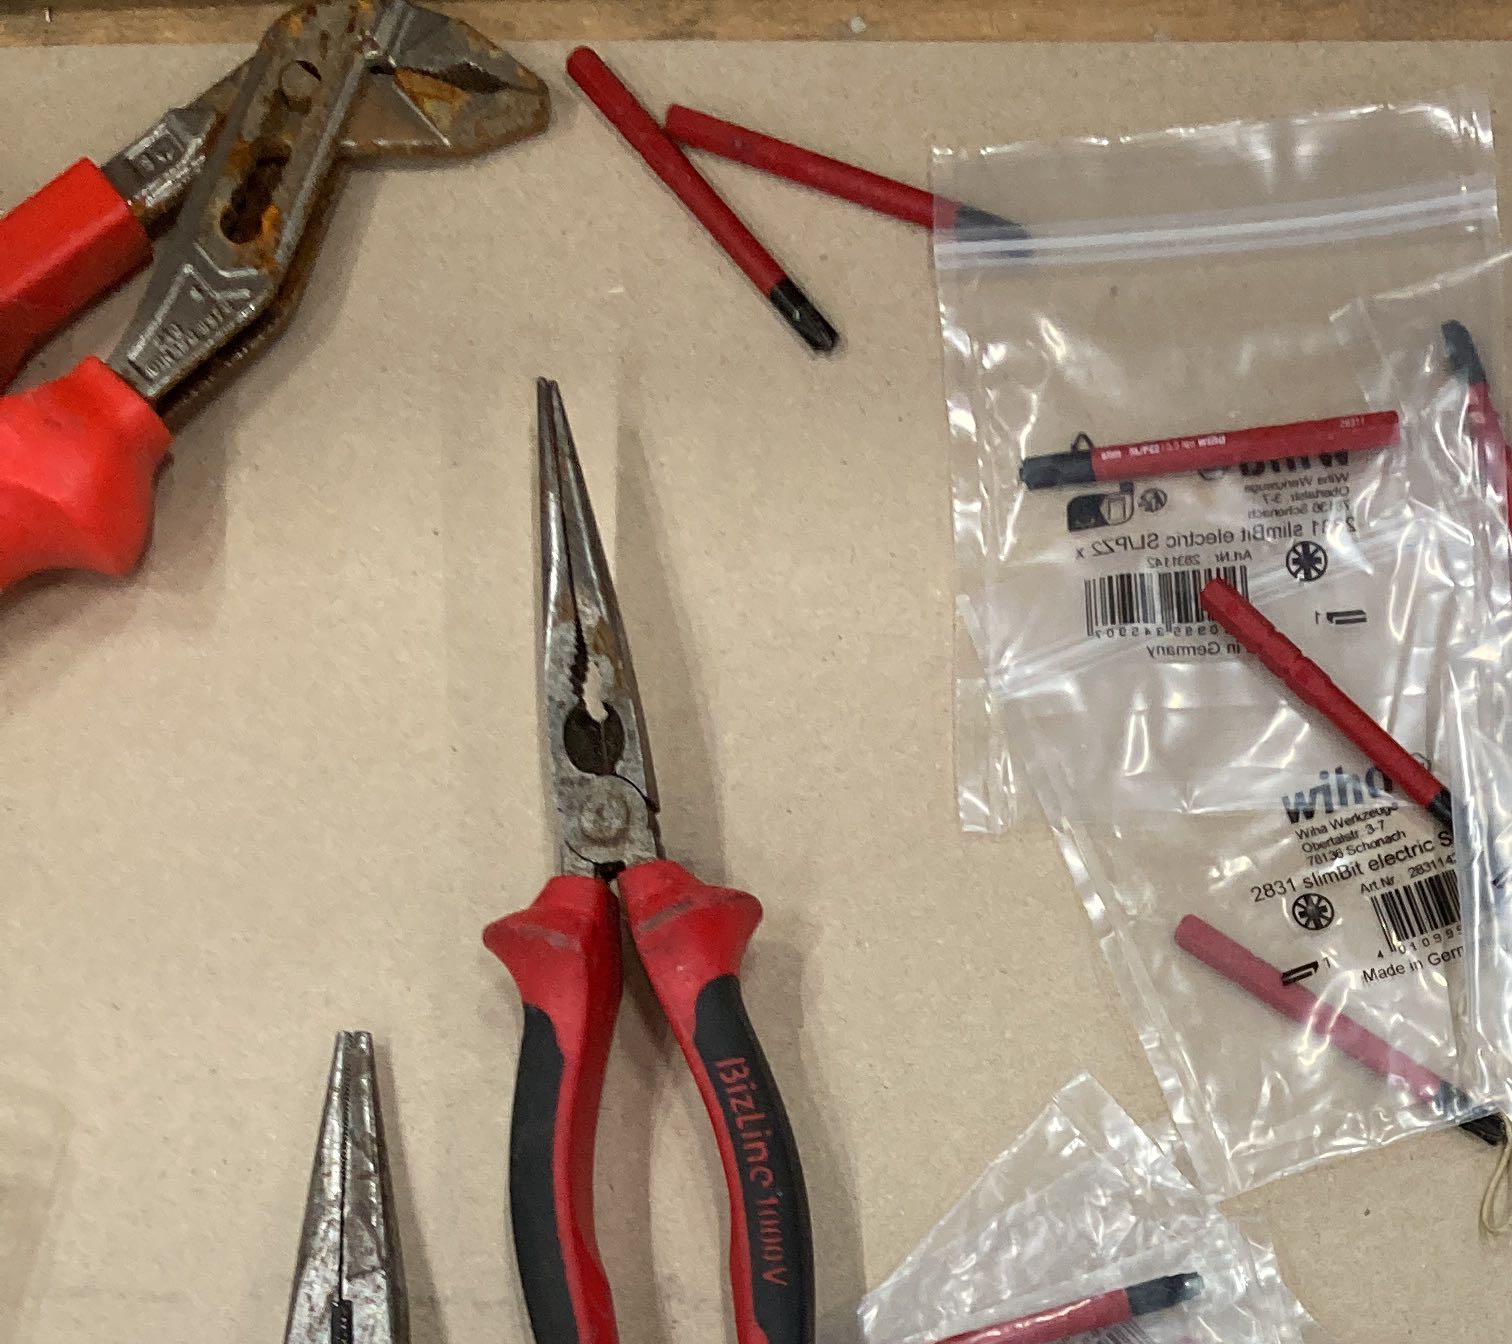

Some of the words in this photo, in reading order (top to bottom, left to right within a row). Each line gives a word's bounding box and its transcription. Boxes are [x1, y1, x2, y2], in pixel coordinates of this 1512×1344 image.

[1295, 822, 1327, 840] Wiha
[1345, 829, 1406, 856] Schonach
[1251, 878, 1297, 902] 2831
[1303, 861, 1362, 889] slimBit
[1367, 838, 1434, 871] electric
[1362, 961, 1405, 984] Made
[1408, 958, 1423, 971] in
[715, 1056, 776, 1188] BizLine
